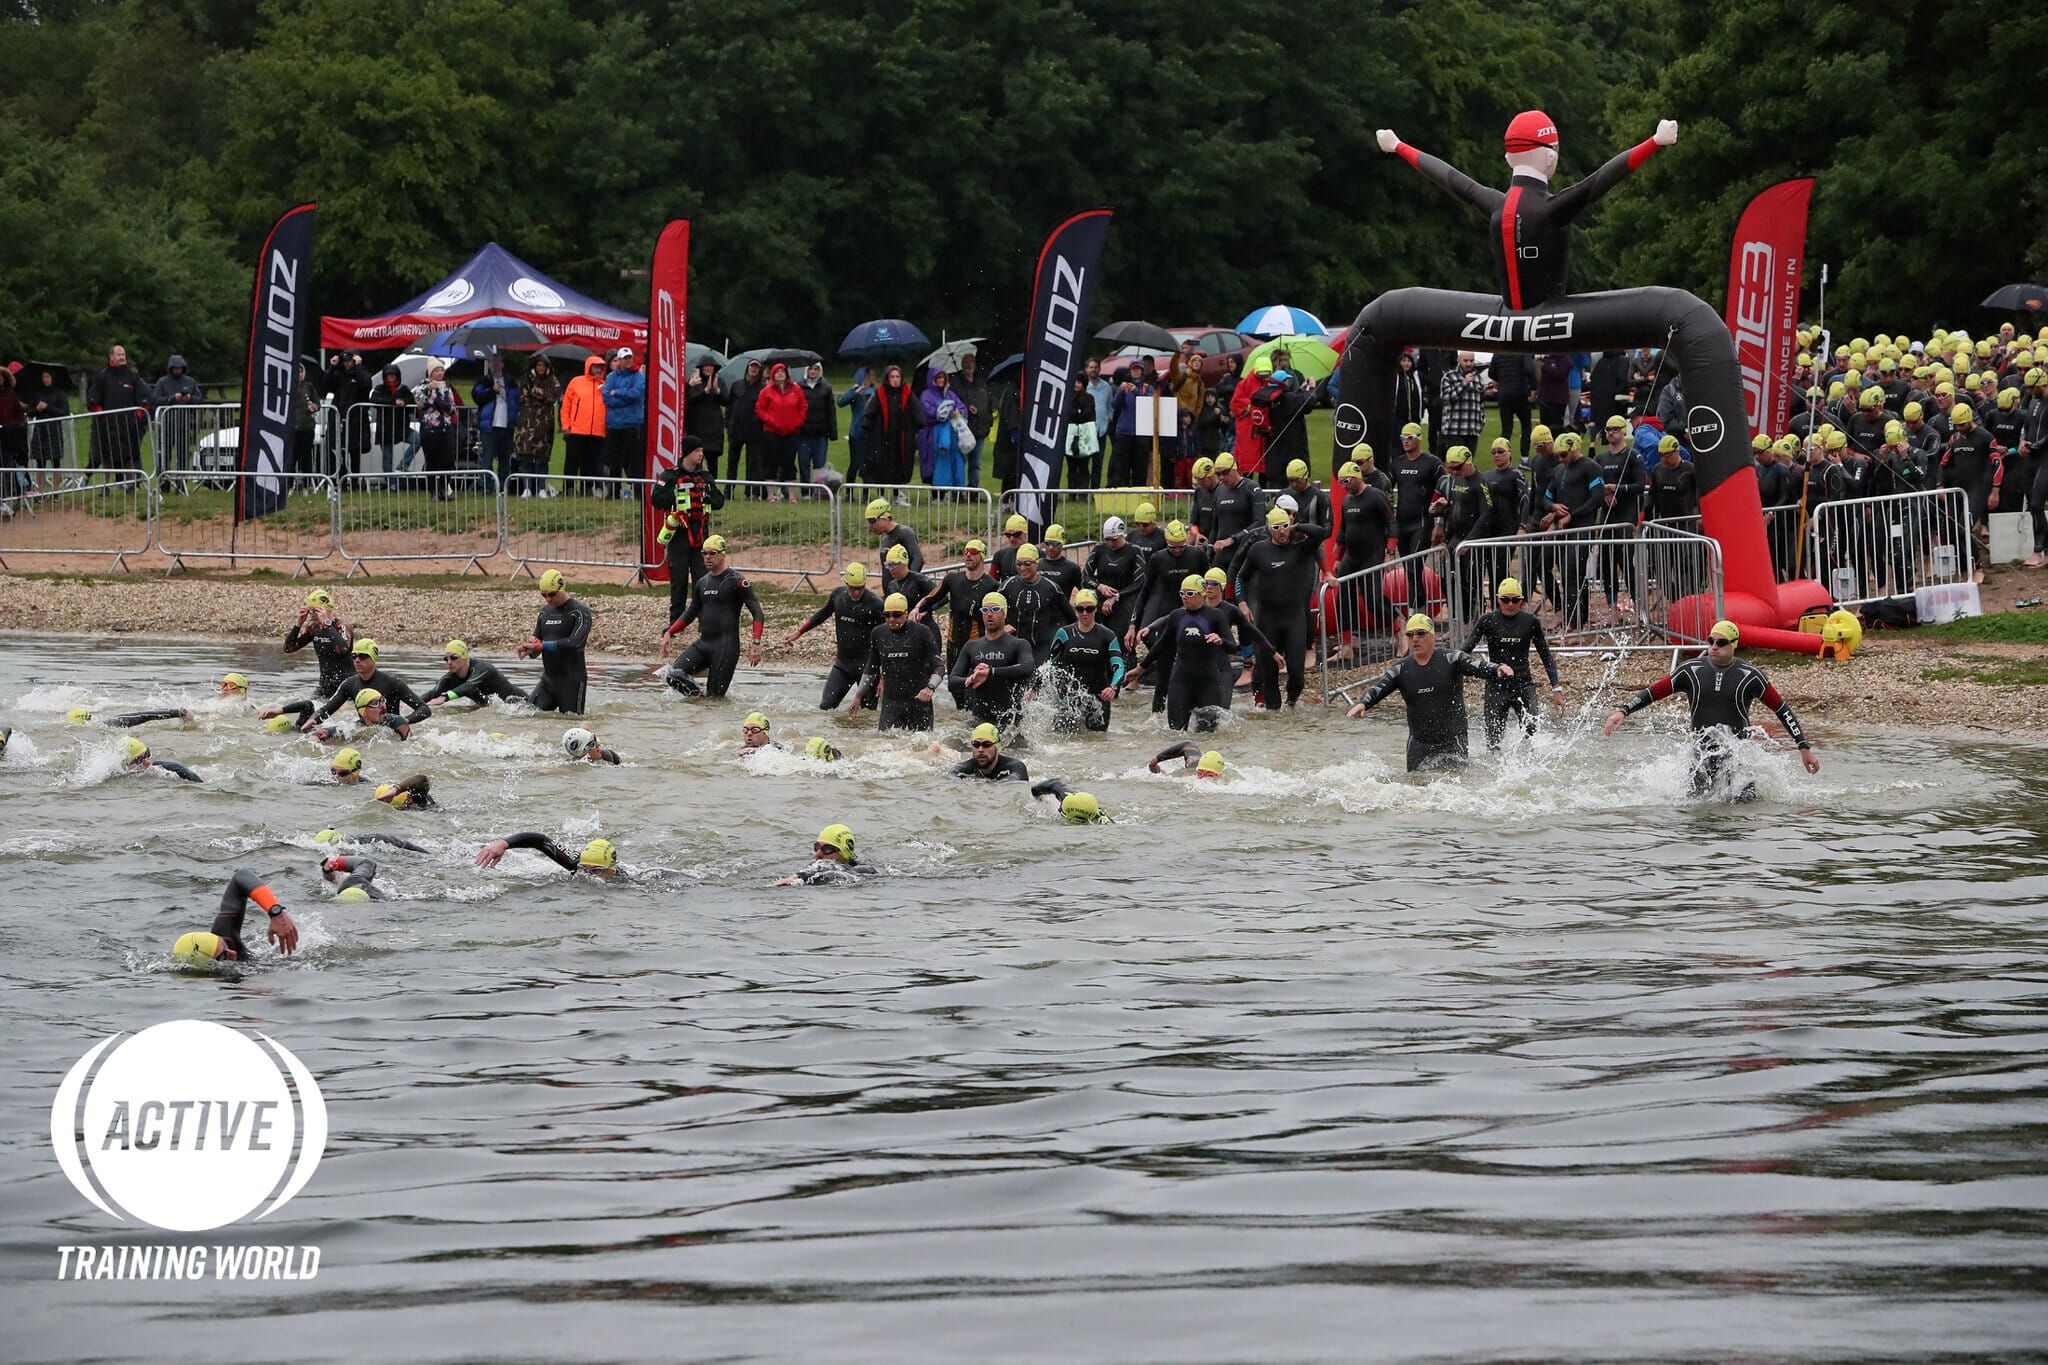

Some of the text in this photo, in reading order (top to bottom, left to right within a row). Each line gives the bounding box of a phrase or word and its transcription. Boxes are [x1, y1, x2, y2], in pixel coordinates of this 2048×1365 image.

[1537, 126, 1557, 138] ZONE
[1786, 258, 1797, 277] IN
[1783, 282, 1796, 330] BUILT
[262, 249, 298, 426] ZONE3
[561, 323, 595, 338] TRAINING
[595, 325, 621, 340] WORLD
[1460, 312, 1575, 343] ZONE3
[1736, 241, 1773, 428] ONE3
[1029, 255, 1085, 450] ZONE3
[1691, 423, 1718, 435] ZONE3
[985, 651, 1005, 661] dhb
